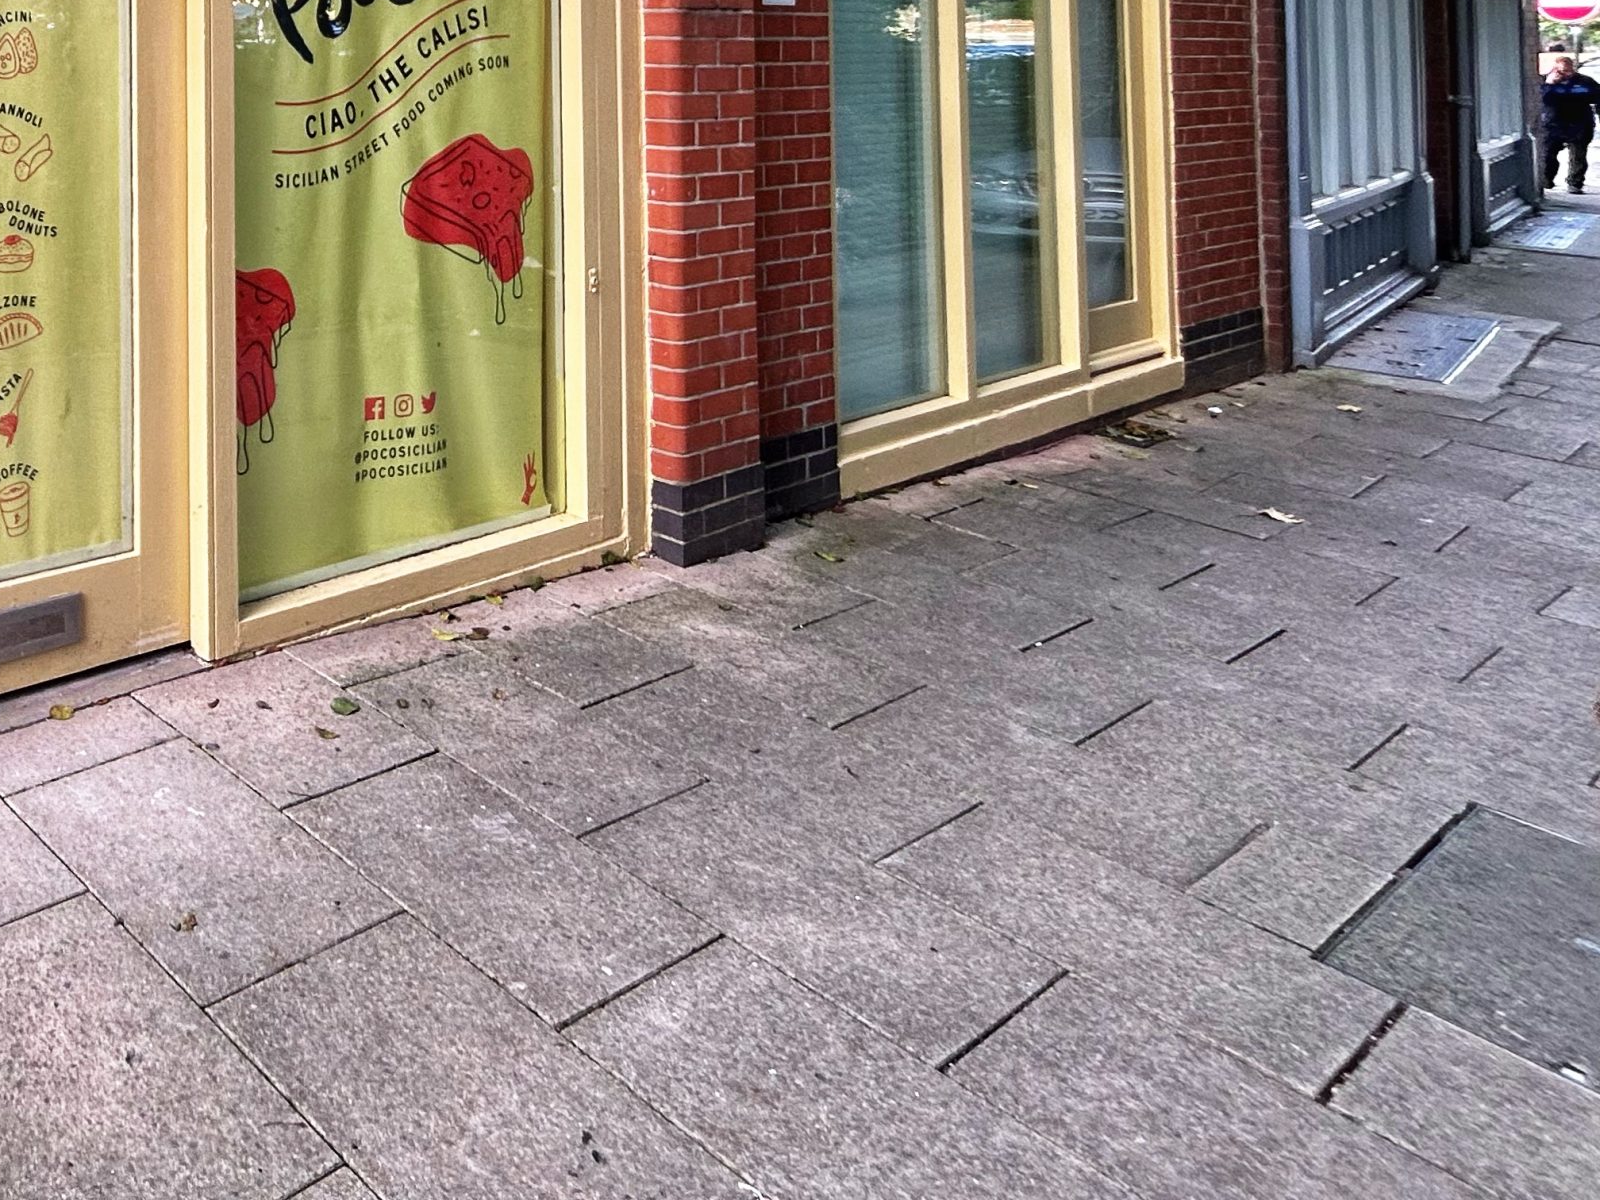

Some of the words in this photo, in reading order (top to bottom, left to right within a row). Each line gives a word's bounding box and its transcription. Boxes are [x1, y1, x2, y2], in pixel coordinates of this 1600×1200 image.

[305, 101, 364, 139] CIAO,
[367, 54, 414, 103] THE
[417, 5, 489, 59] CALLS!
[275, 165, 339, 189] SICILIAN
[344, 132, 390, 174] STREET
[392, 100, 426, 138] FOOD
[427, 62, 473, 103] COMING
[478, 55, 510, 72] SOON
[8, 215, 58, 237] DONUTS
[363, 426, 416, 443] FOLLOW
[421, 423, 440, 437] US:
[354, 438, 447, 464] @POCOSICILIAN
[355, 457, 447, 482] #POCOSICILIAN
